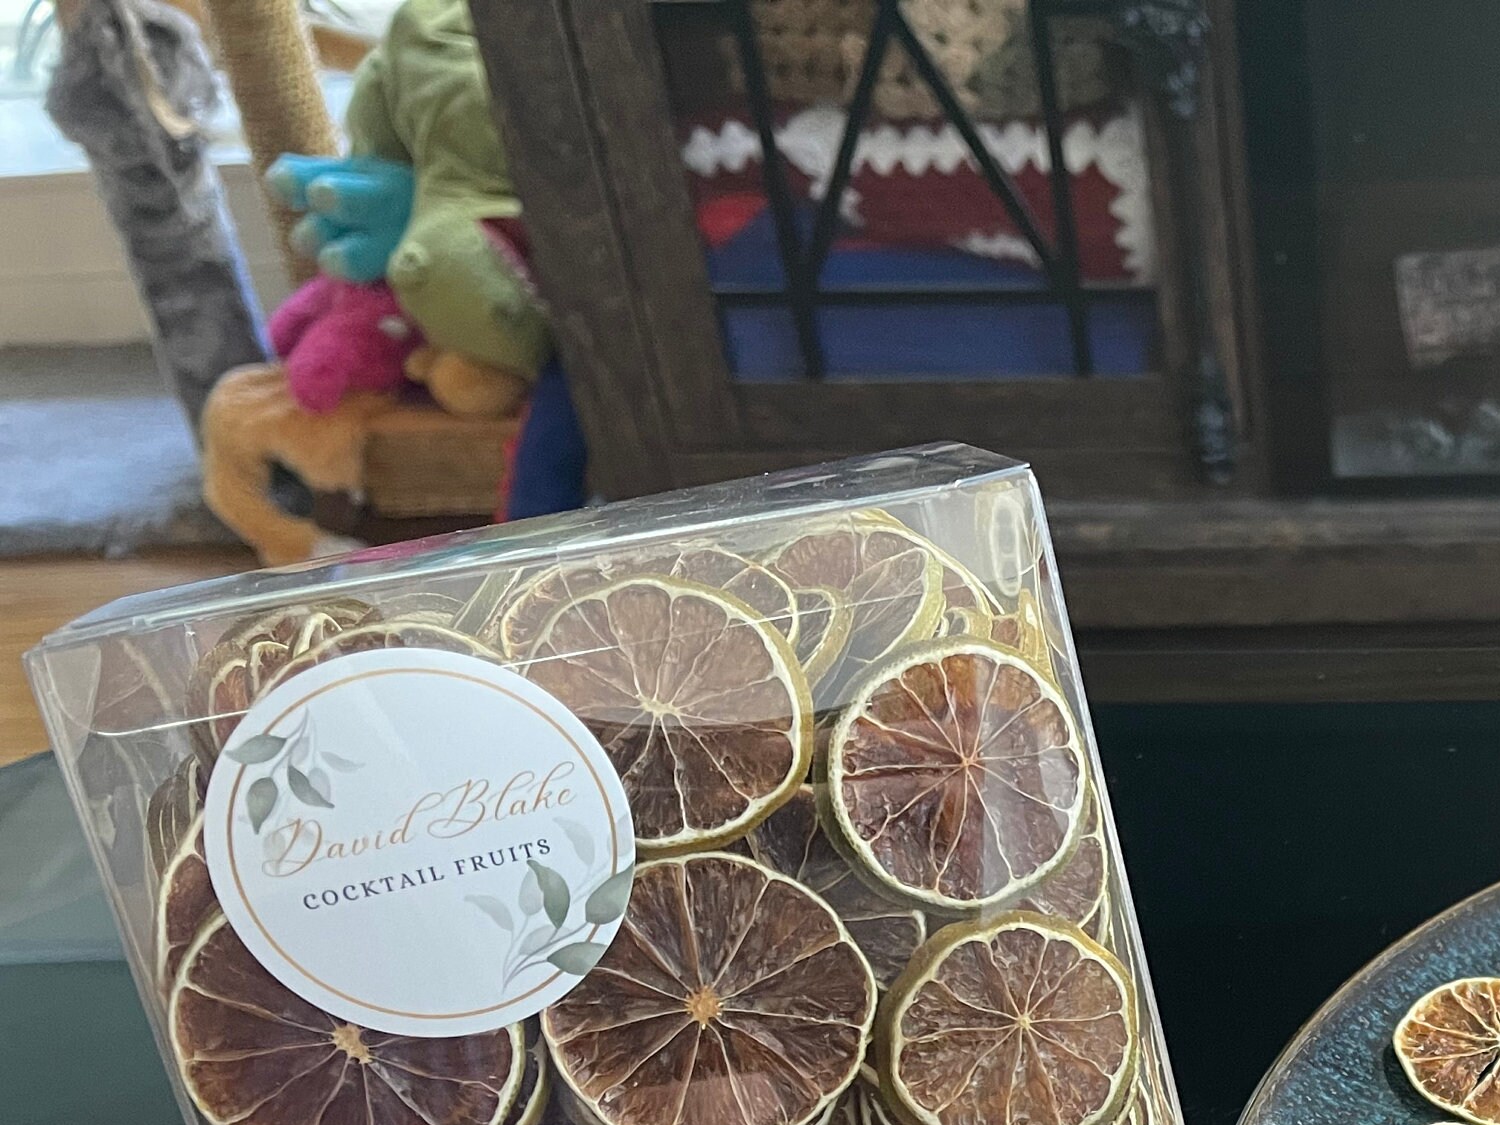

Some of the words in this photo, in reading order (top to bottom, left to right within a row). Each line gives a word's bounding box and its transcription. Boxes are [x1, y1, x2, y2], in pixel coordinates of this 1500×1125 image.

[261, 791, 442, 878] David
[427, 760, 577, 839] Blake
[303, 865, 446, 910] COCKTAIL
[454, 838, 552, 876] FRUITS
